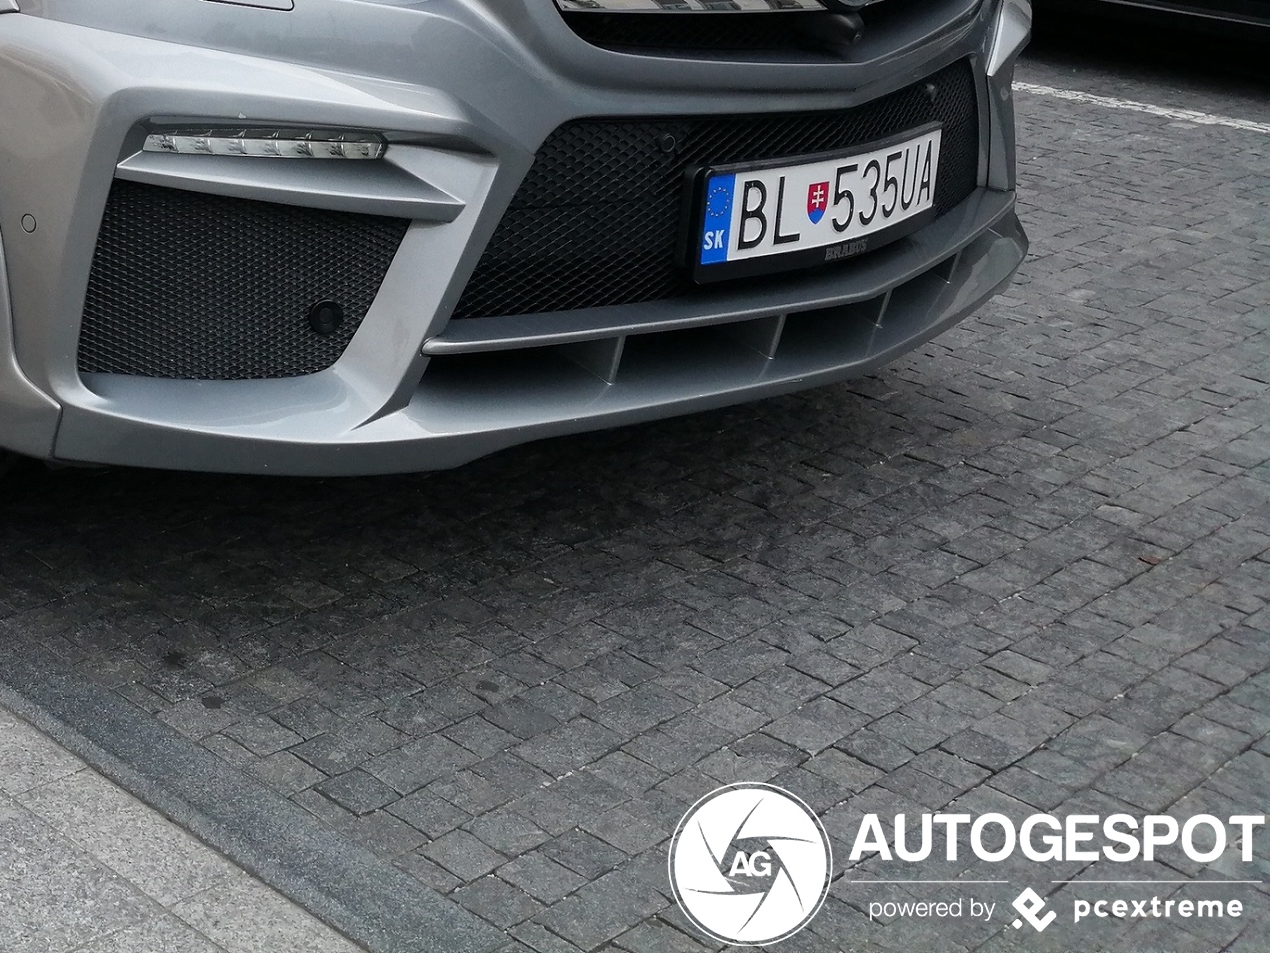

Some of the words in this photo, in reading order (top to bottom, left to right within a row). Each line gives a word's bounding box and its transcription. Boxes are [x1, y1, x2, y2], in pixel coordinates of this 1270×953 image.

[736, 175, 800, 252] BL
[831, 139, 934, 233] 535UA
[703, 229, 725, 251] SK
